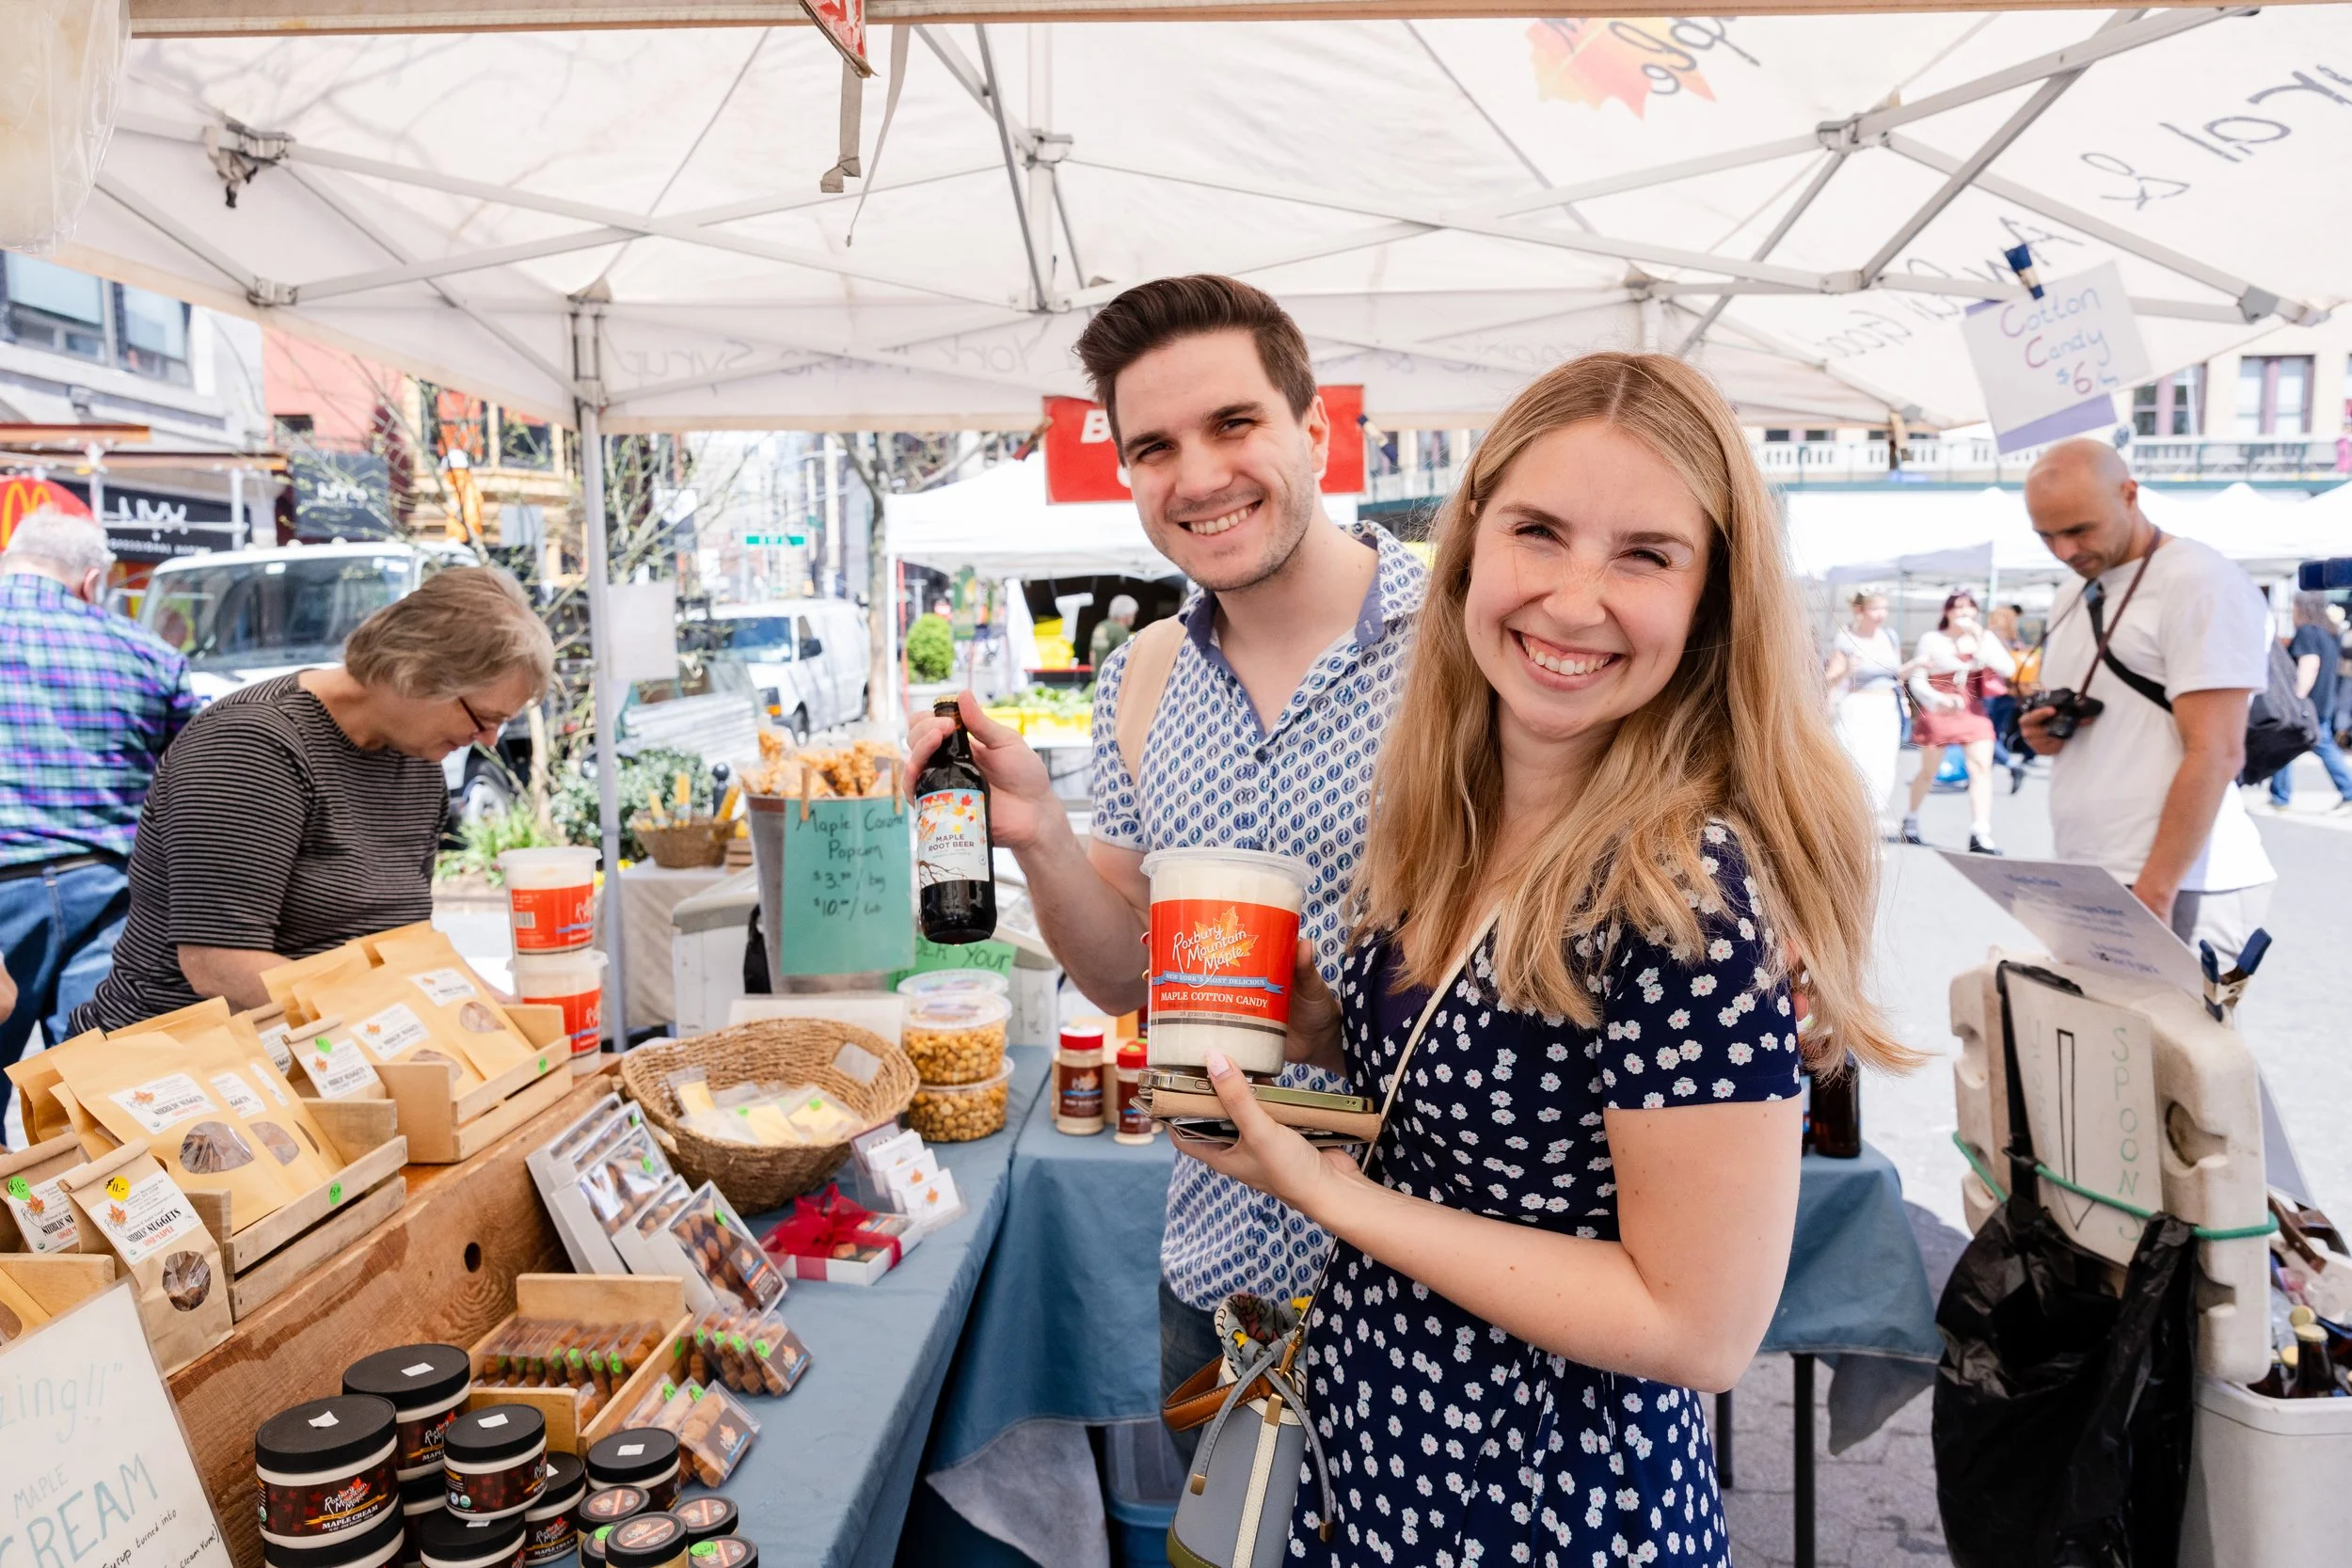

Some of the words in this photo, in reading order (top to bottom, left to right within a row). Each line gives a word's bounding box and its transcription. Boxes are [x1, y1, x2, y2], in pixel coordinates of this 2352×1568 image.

[2001, 287, 2102, 338] Cotton
[2026, 325, 2110, 367] Candy
[928, 842, 950, 852] ROOT
[935, 833, 965, 843] MAPLE
[1172, 923, 1224, 965] Roxbury
[1186, 929, 1248, 970] Mountain
[1203, 946, 1245, 975] Maple
[1205, 975, 1228, 984] MOST
[1228, 977, 1265, 986] DELICIOUS
[1160, 991, 1189, 1002] MAPLE
[1190, 991, 1234, 1004] COTTON
[1235, 995, 1269, 1008] CANDY
[146, 1207, 182, 1234] NUGGETS
[13, 1461, 70, 1520] MAPLE
[324, 1485, 355, 1514] Roxbury
[161, 1508, 178, 1528] into
[322, 1515, 352, 1529] MAPLE
[351, 1504, 378, 1521] CREAM
